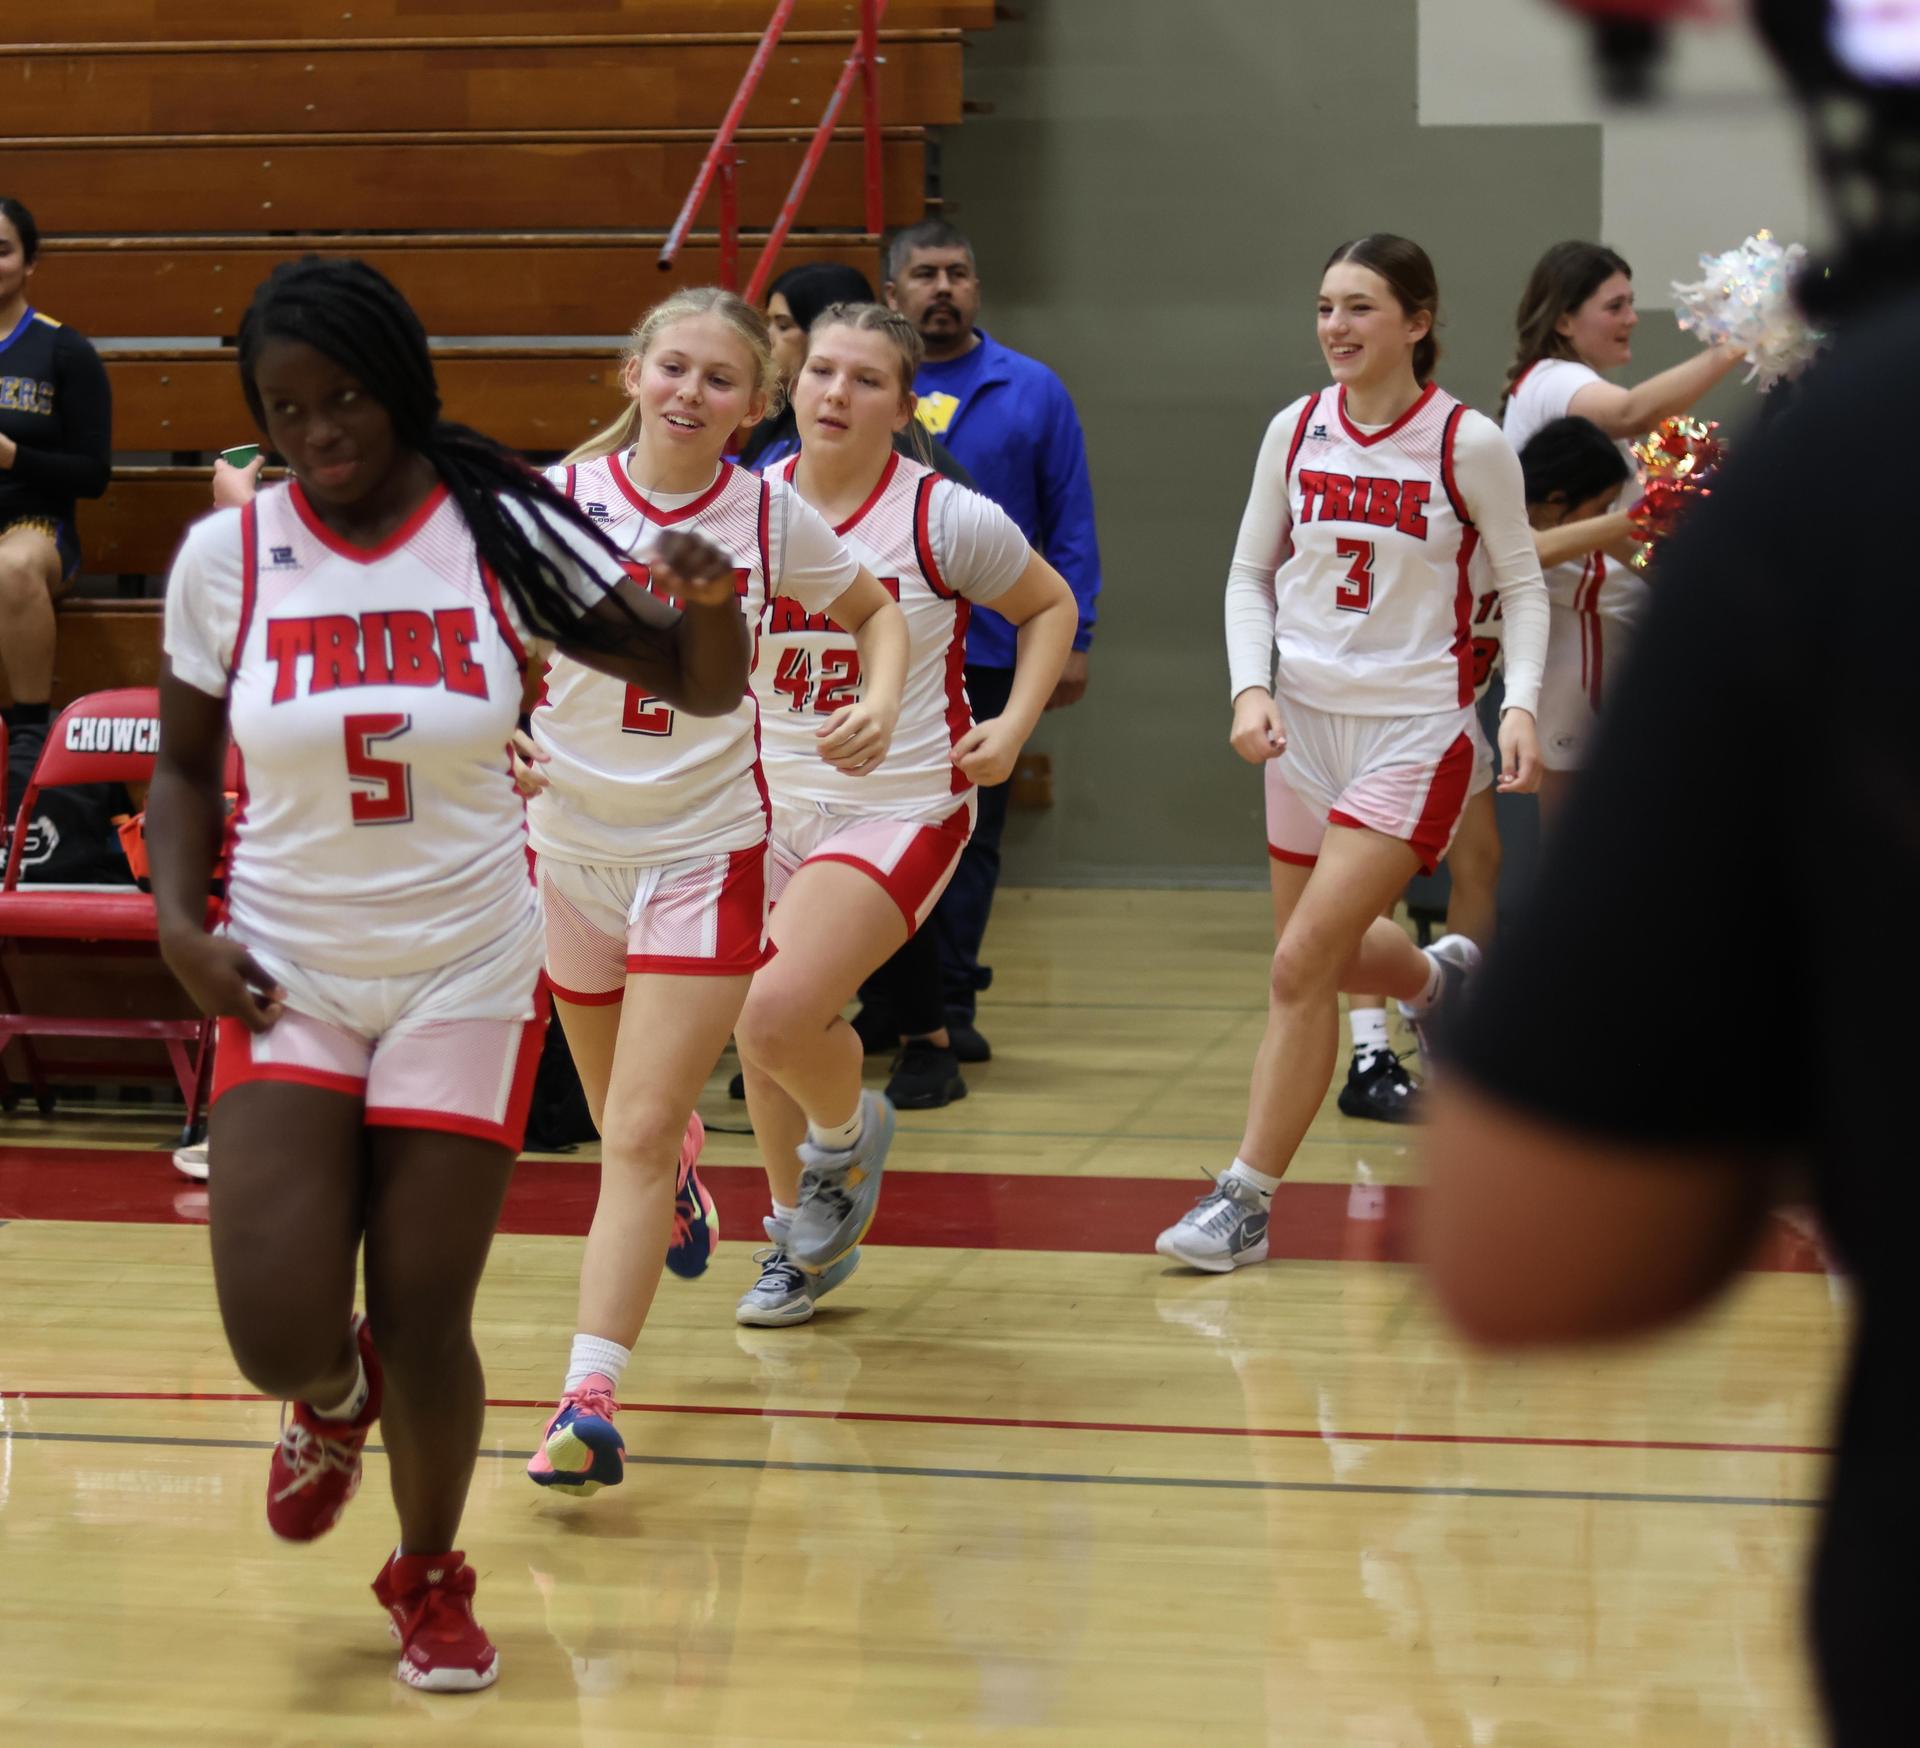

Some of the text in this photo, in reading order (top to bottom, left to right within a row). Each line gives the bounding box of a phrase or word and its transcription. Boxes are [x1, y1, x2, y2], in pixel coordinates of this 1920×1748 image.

[0, 376, 54, 415] ERS
[1298, 468, 1432, 541] TRIBE
[1336, 537, 1375, 614] 3
[266, 607, 490, 706] TRIBE
[773, 647, 863, 715] 42
[65, 717, 160, 752] CHOWCH
[343, 712, 414, 827] 5
